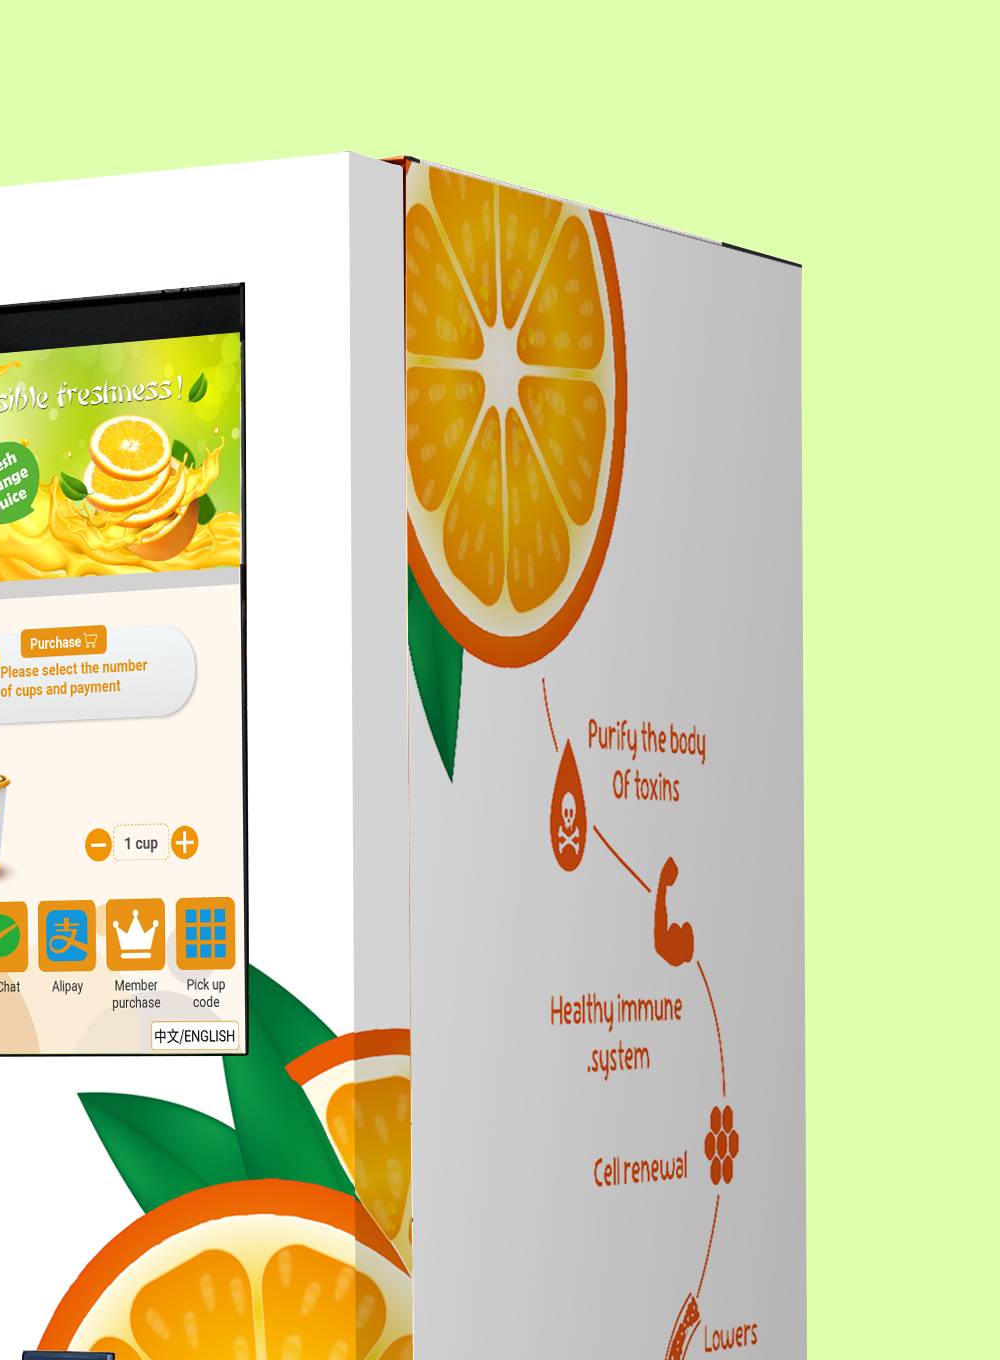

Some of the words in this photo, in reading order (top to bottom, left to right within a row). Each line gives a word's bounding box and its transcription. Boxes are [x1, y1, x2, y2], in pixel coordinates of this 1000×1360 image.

[30, 636, 82, 650] Purchase
[0, 665, 39, 679] Please
[42, 662, 77, 677] select
[81, 661, 99, 675] the
[102, 659, 148, 673] number
[0, 684, 13, 697] of
[15, 685, 43, 699] cups
[46, 682, 67, 695] and
[70, 679, 121, 697] payment
[588, 719, 637, 761] Purify
[641, 721, 667, 753] the
[670, 724, 706, 765] body
[613, 769, 631, 799] Of
[634, 769, 680, 802] toxins
[125, 837, 131, 849] 1
[136, 838, 158, 853] cup
[52, 979, 84, 995] Alipay
[114, 979, 158, 991] Member
[186, 978, 209, 991] Pick
[212, 980, 226, 993] up
[112, 996, 161, 1011] purchase
[193, 995, 220, 1008] code
[551, 992, 614, 1032] Healthy
[617, 993, 683, 1023] immune
[154, 1028, 235, 1045] 中文/ENGLISH
[594, 1157, 620, 1187] Cell
[623, 1151, 688, 1184] renewal
[702, 1323, 758, 1353] Lowers
